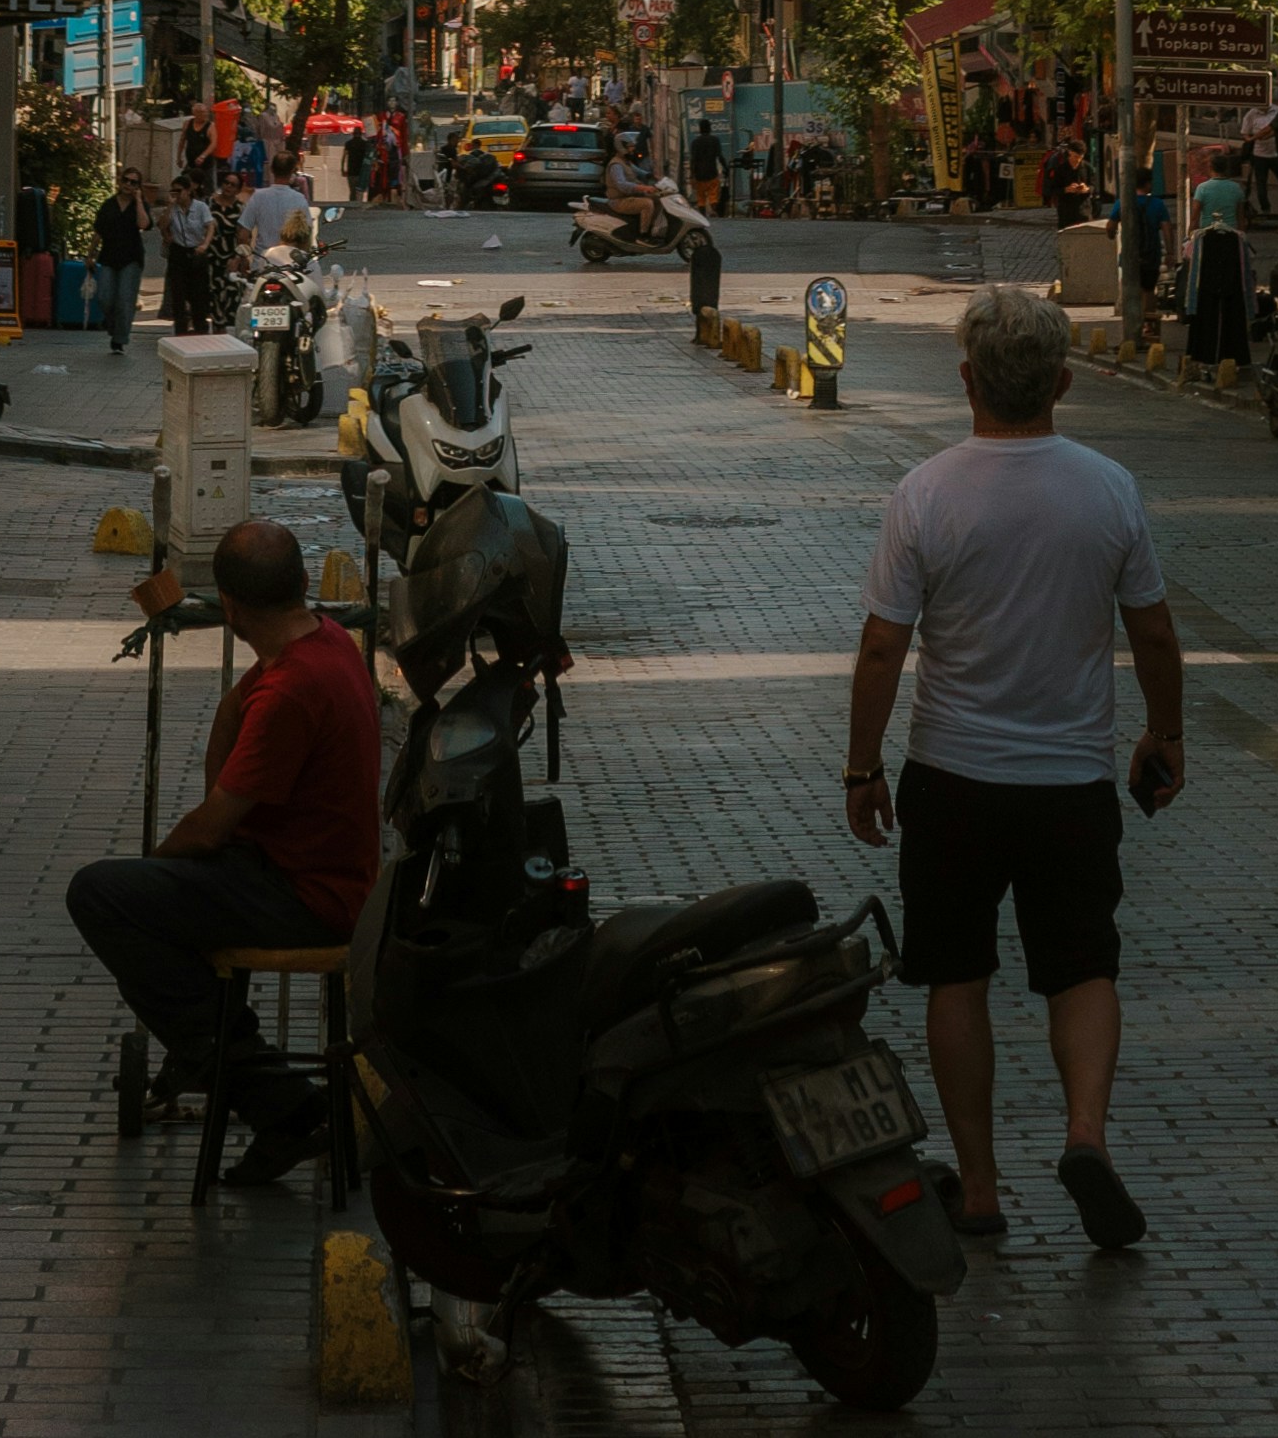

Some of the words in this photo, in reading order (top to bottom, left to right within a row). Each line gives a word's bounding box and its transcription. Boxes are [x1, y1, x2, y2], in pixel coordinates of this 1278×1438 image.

[637, 26, 650, 38] 20
[1156, 18, 1236, 36] Ayasofya
[1156, 37, 1213, 52] Topkapı
[1219, 39, 1264, 55] Sarayı
[1156, 77, 1262, 97] Sultanahmet
